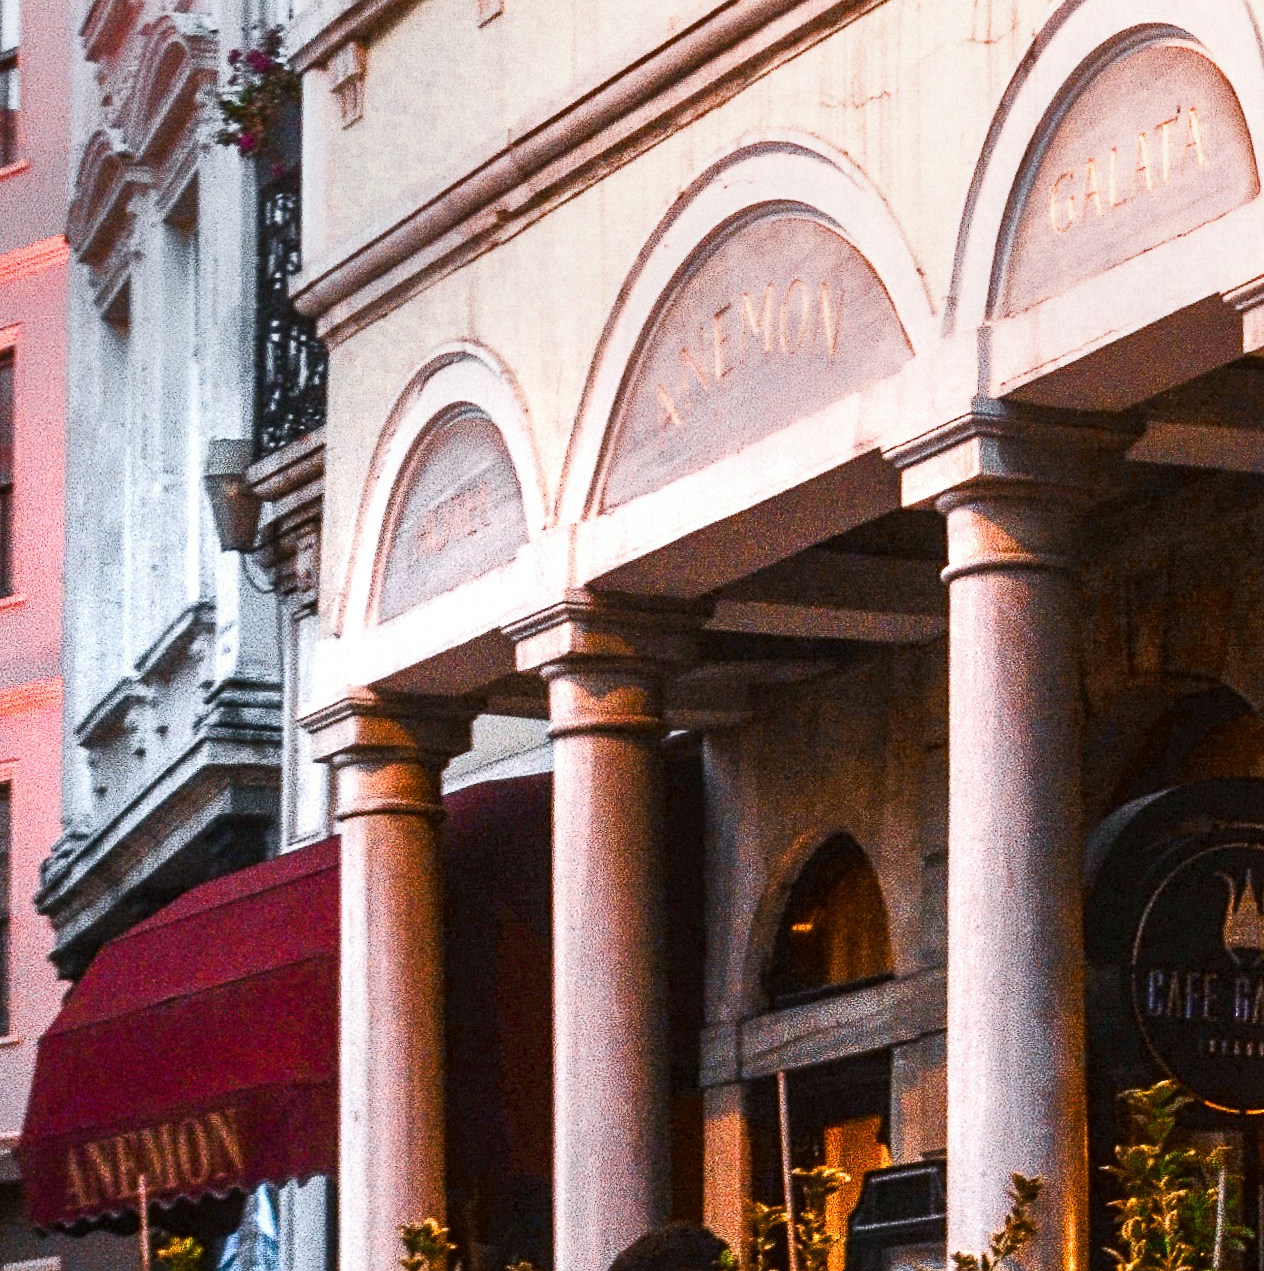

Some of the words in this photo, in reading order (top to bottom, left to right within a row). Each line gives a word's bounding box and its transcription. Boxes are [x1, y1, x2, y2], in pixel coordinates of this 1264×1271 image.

[1050, 105, 1208, 233] GALATA
[655, 277, 846, 443] ANEMON
[64, 1106, 245, 1211] ANEMON
